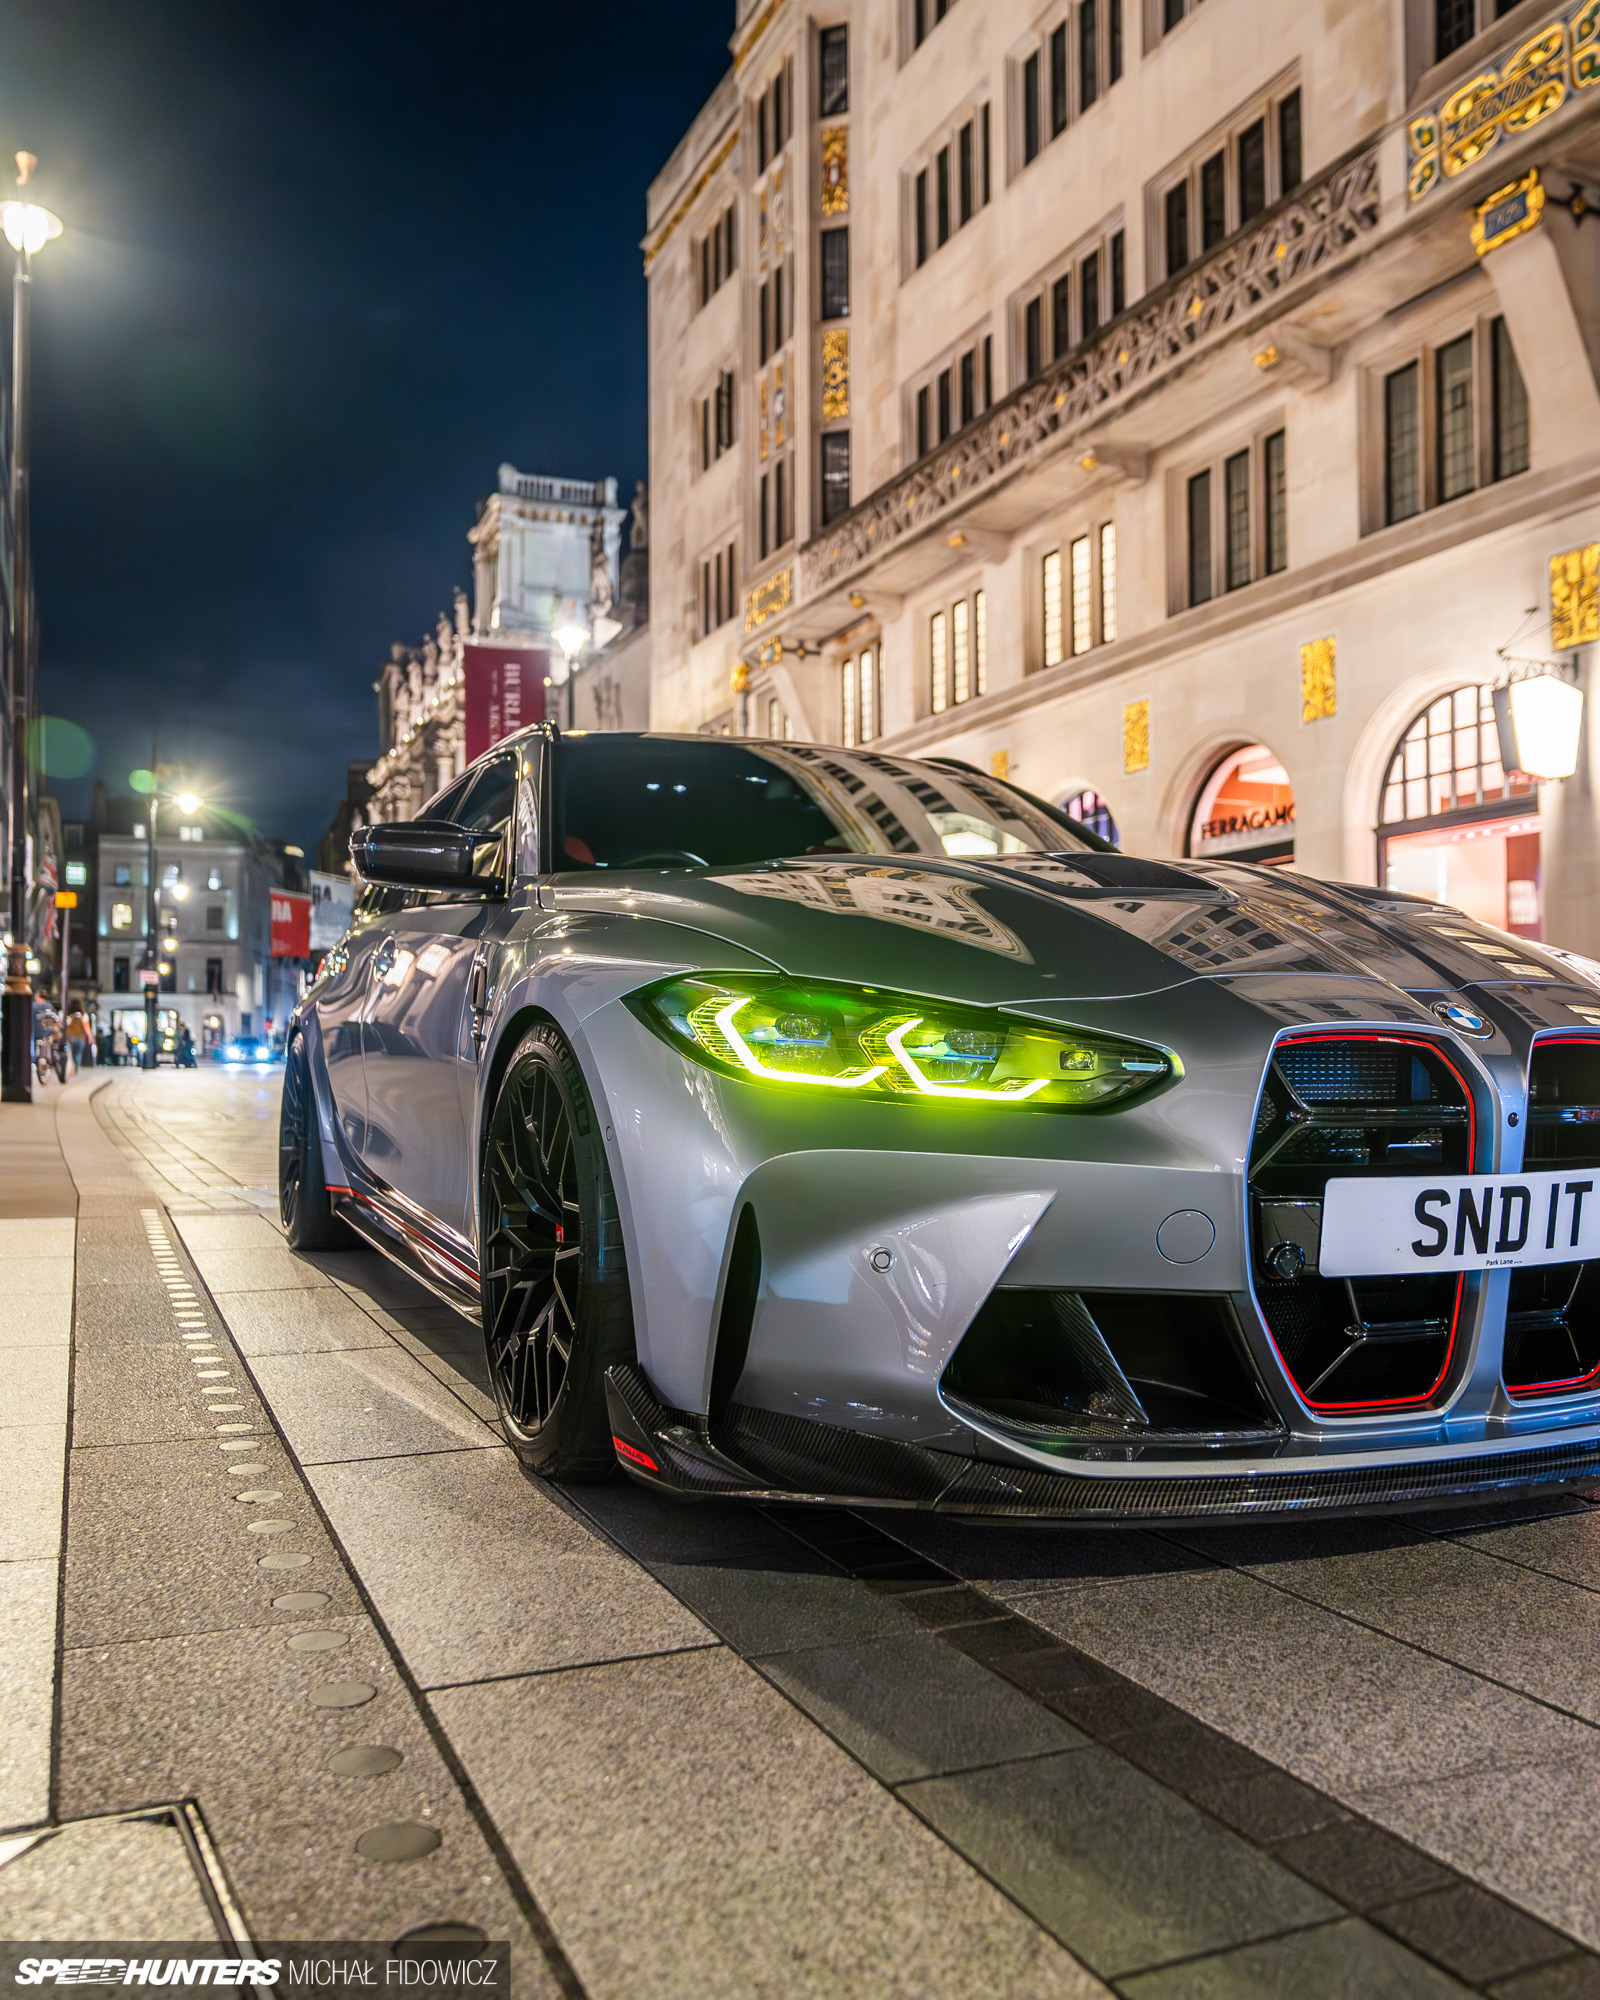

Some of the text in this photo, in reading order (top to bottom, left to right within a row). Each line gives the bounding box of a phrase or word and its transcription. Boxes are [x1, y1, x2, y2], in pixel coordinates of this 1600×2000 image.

[503, 663, 521, 735] BURLI
[1411, 1181, 1593, 1257] SND IT
